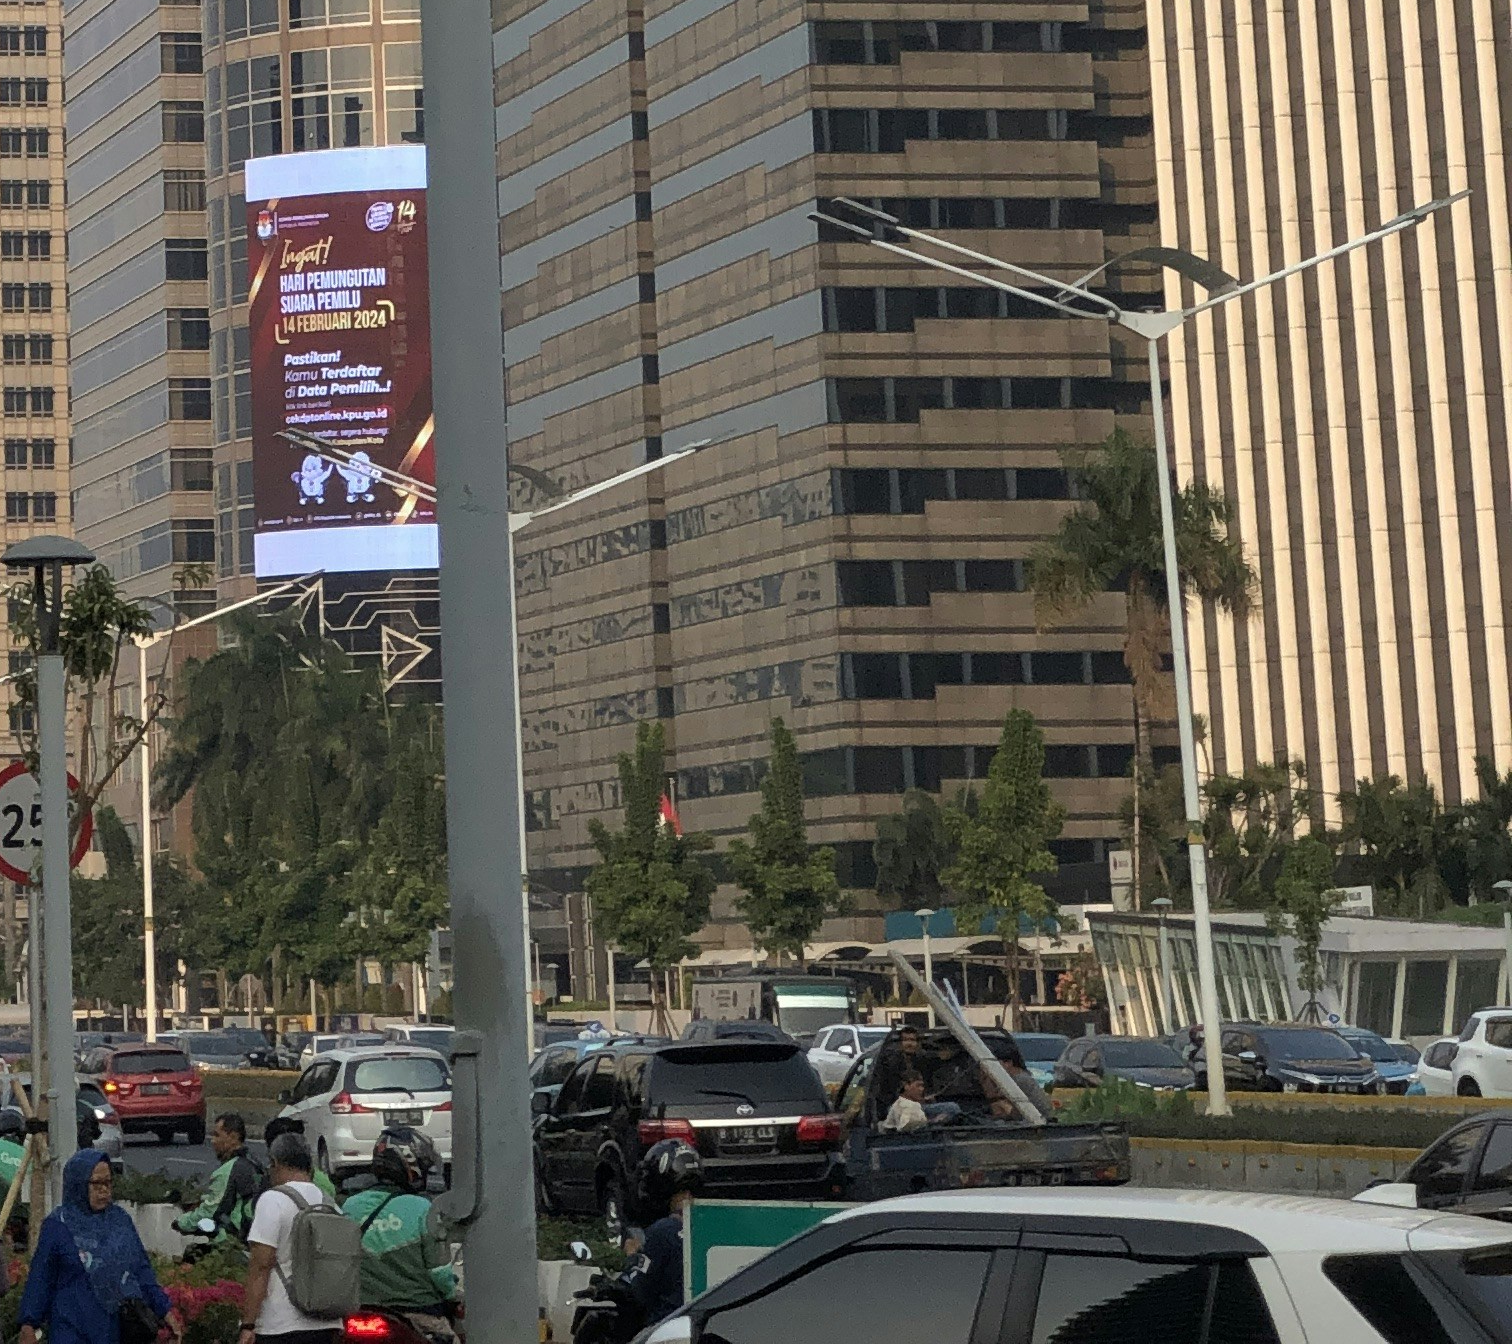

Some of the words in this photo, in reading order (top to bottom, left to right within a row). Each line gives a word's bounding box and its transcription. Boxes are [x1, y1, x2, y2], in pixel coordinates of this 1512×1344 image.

[280, 236, 333, 272] Ingat!
[280, 275, 305, 292] HARI
[307, 268, 385, 290] PEMUNGUTAN
[280, 294, 316, 314] SUARA
[317, 290, 361, 312] PEMILU
[283, 317, 296, 334] 14
[297, 311, 351, 333] FEBRUARI
[354, 310, 387, 329] 2024
[284, 350, 341, 366] Pastikan!
[285, 370, 318, 382] Kamu
[321, 364, 382, 379] Terdaftar
[285, 385, 296, 398] di
[298, 384, 328, 397] Data
